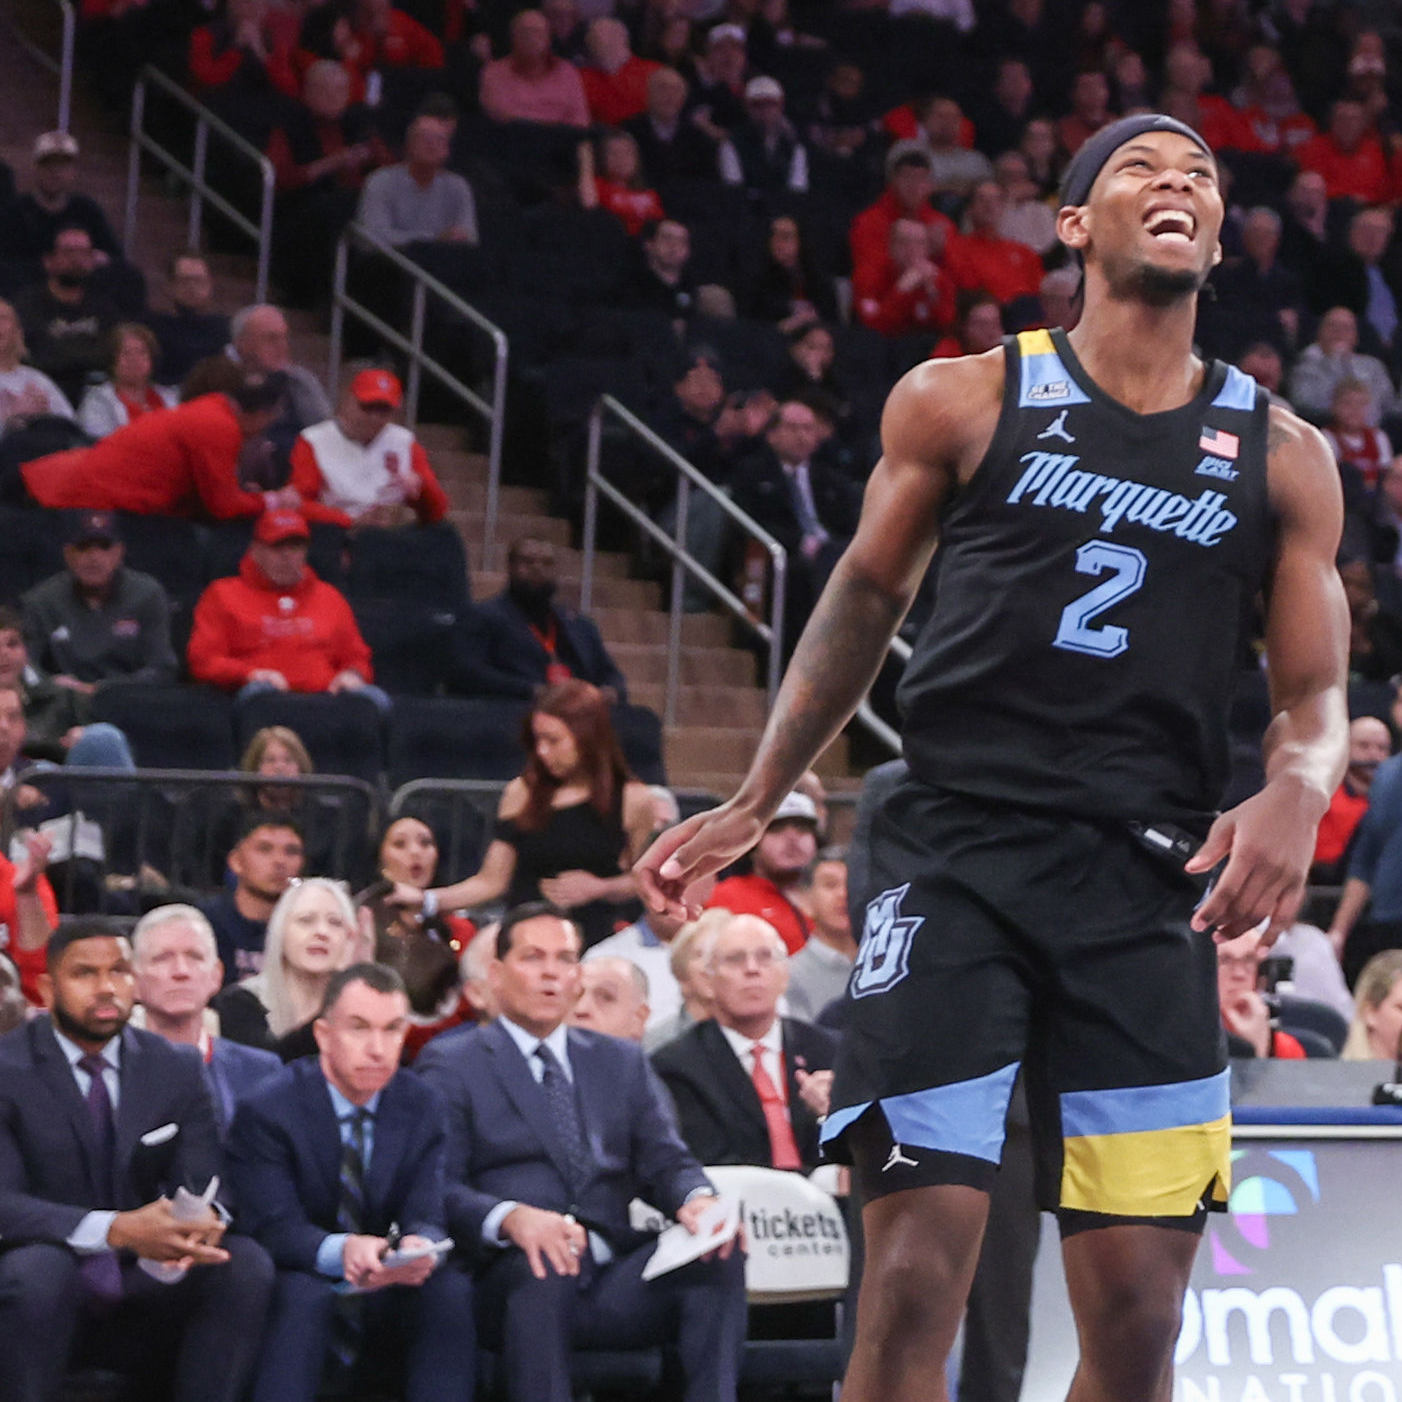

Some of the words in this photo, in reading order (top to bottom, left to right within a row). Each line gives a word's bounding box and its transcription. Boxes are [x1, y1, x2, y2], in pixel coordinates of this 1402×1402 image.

[1006, 451, 1238, 547] Marquette
[1052, 538, 1148, 659] 2
[751, 1207, 840, 1240] tickets
